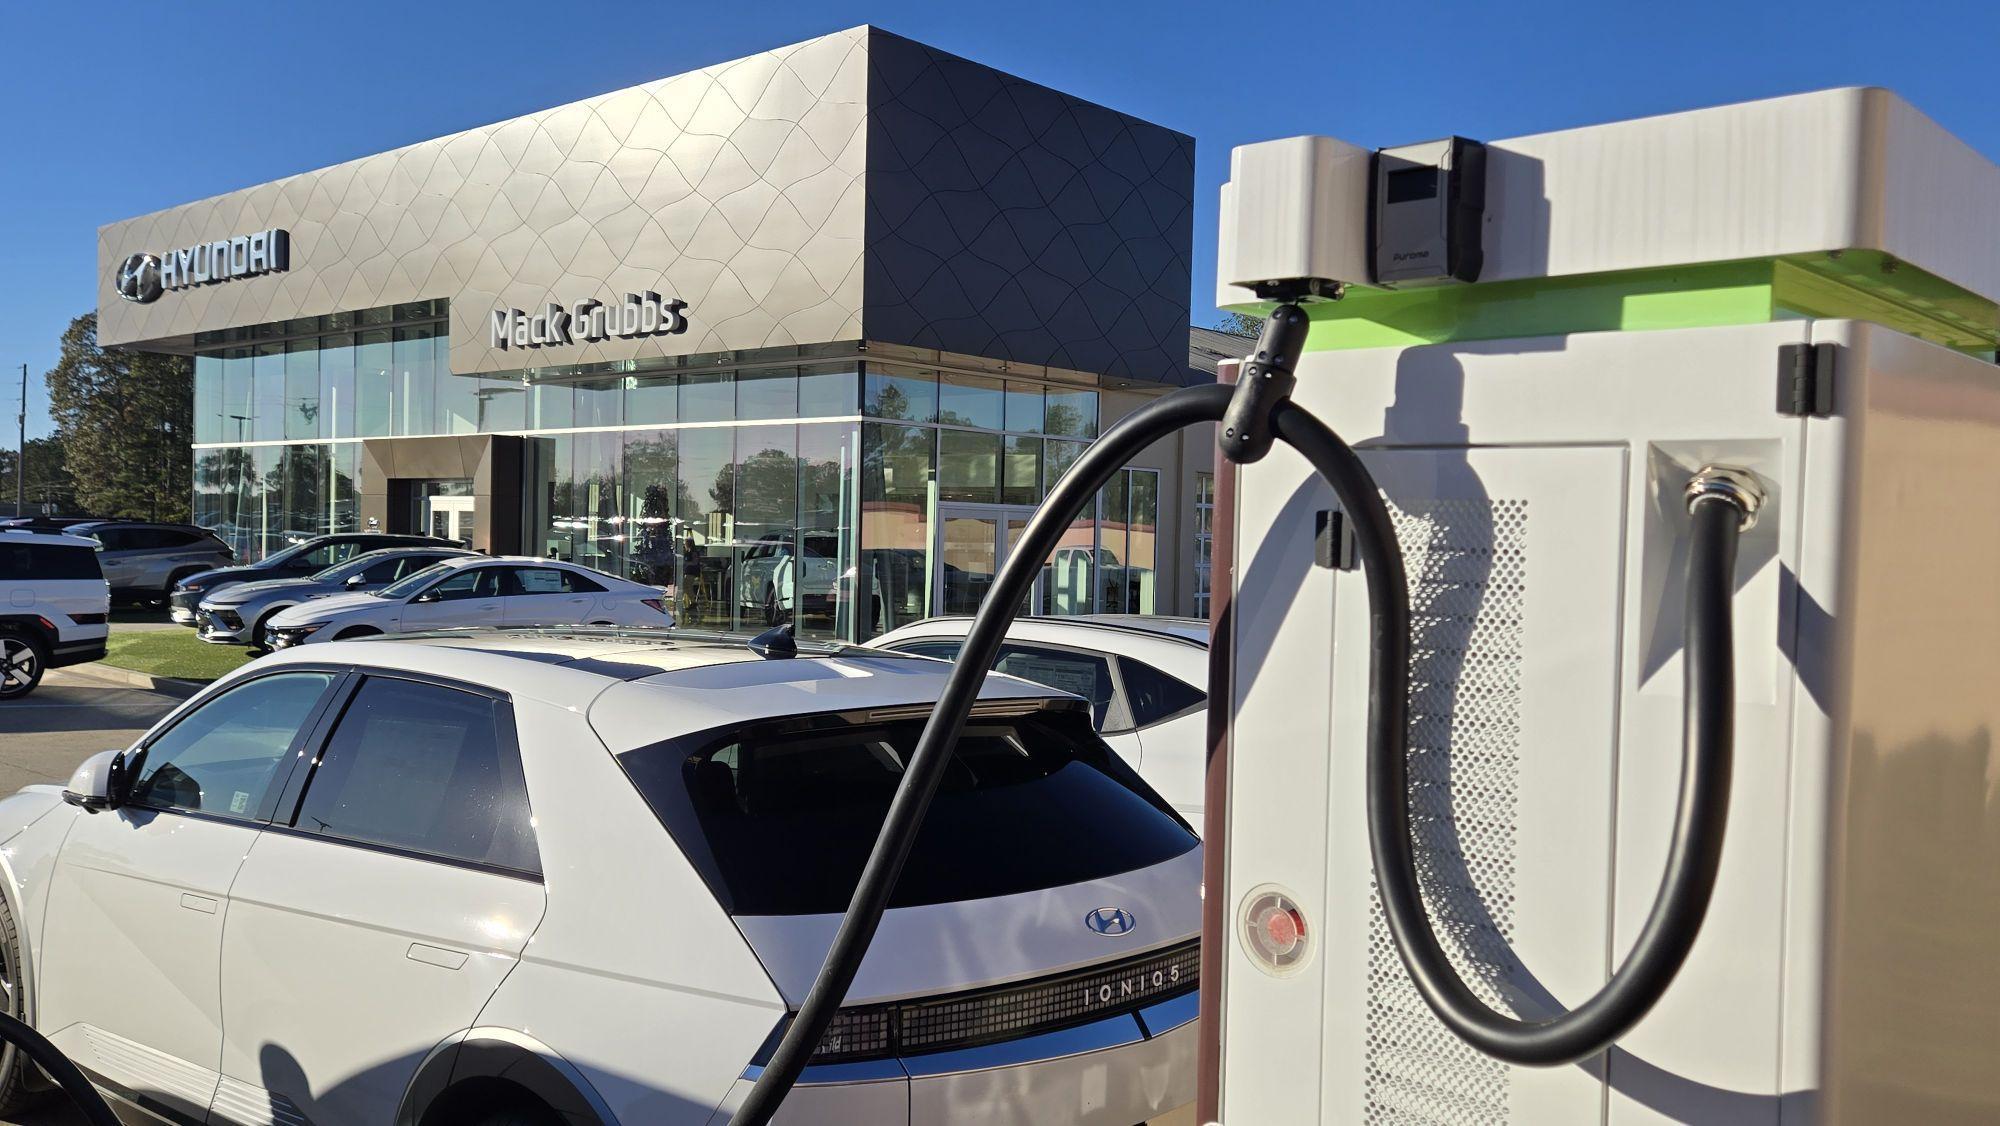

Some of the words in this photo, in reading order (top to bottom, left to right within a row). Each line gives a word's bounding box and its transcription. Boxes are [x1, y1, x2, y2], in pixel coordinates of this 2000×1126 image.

[160, 228, 287, 291] HYUNDAI
[491, 303, 568, 349] Mack
[571, 290, 683, 342] Grubbs
